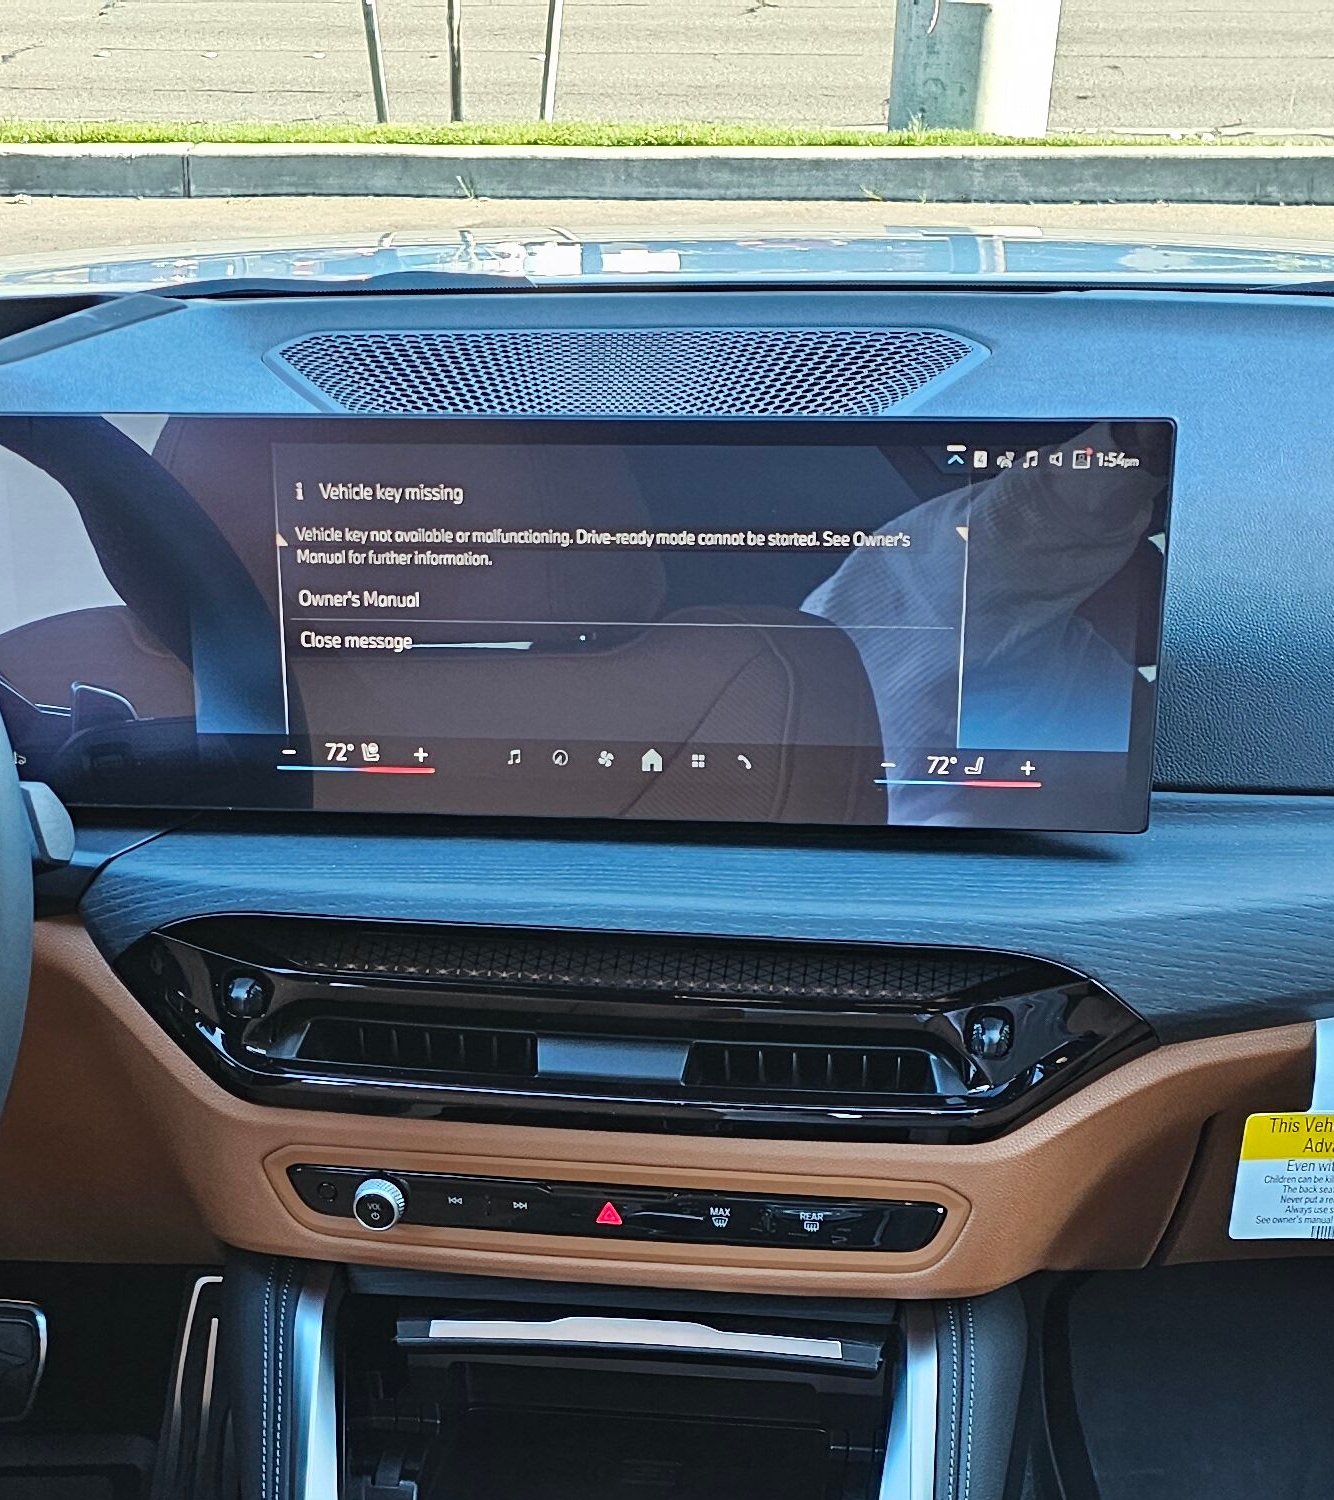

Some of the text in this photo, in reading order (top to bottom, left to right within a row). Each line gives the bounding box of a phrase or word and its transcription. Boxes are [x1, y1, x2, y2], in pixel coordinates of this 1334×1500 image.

[319, 483, 373, 500] Vehicle
[376, 483, 402, 503] key
[405, 483, 463, 504] missing
[295, 527, 911, 548] Vehicle key not available or malfunctioning. Drive-ready mode cannot be started. See Owner's
[296, 549, 492, 566] Manual for further information.
[298, 590, 420, 608] Owner's Manual
[300, 631, 413, 652] Close message
[1270, 1118, 1299, 1133] This
[1287, 1160, 1315, 1172] Even
[1265, 1175, 1296, 1184] Children
[1314, 1176, 1323, 1184] be
[1283, 1185, 1297, 1193] The
[1299, 1185, 1317, 1194] back
[1280, 1195, 1303, 1204] Never
[1305, 1196, 1317, 1205] put
[710, 1207, 731, 1217] MAX
[799, 1211, 824, 1221] REAR
[1285, 1206, 1312, 1216] Always
[1256, 1216, 1270, 1224] See
[1272, 1216, 1302, 1224] owner's
[1304, 1216, 1333, 1224] manual
